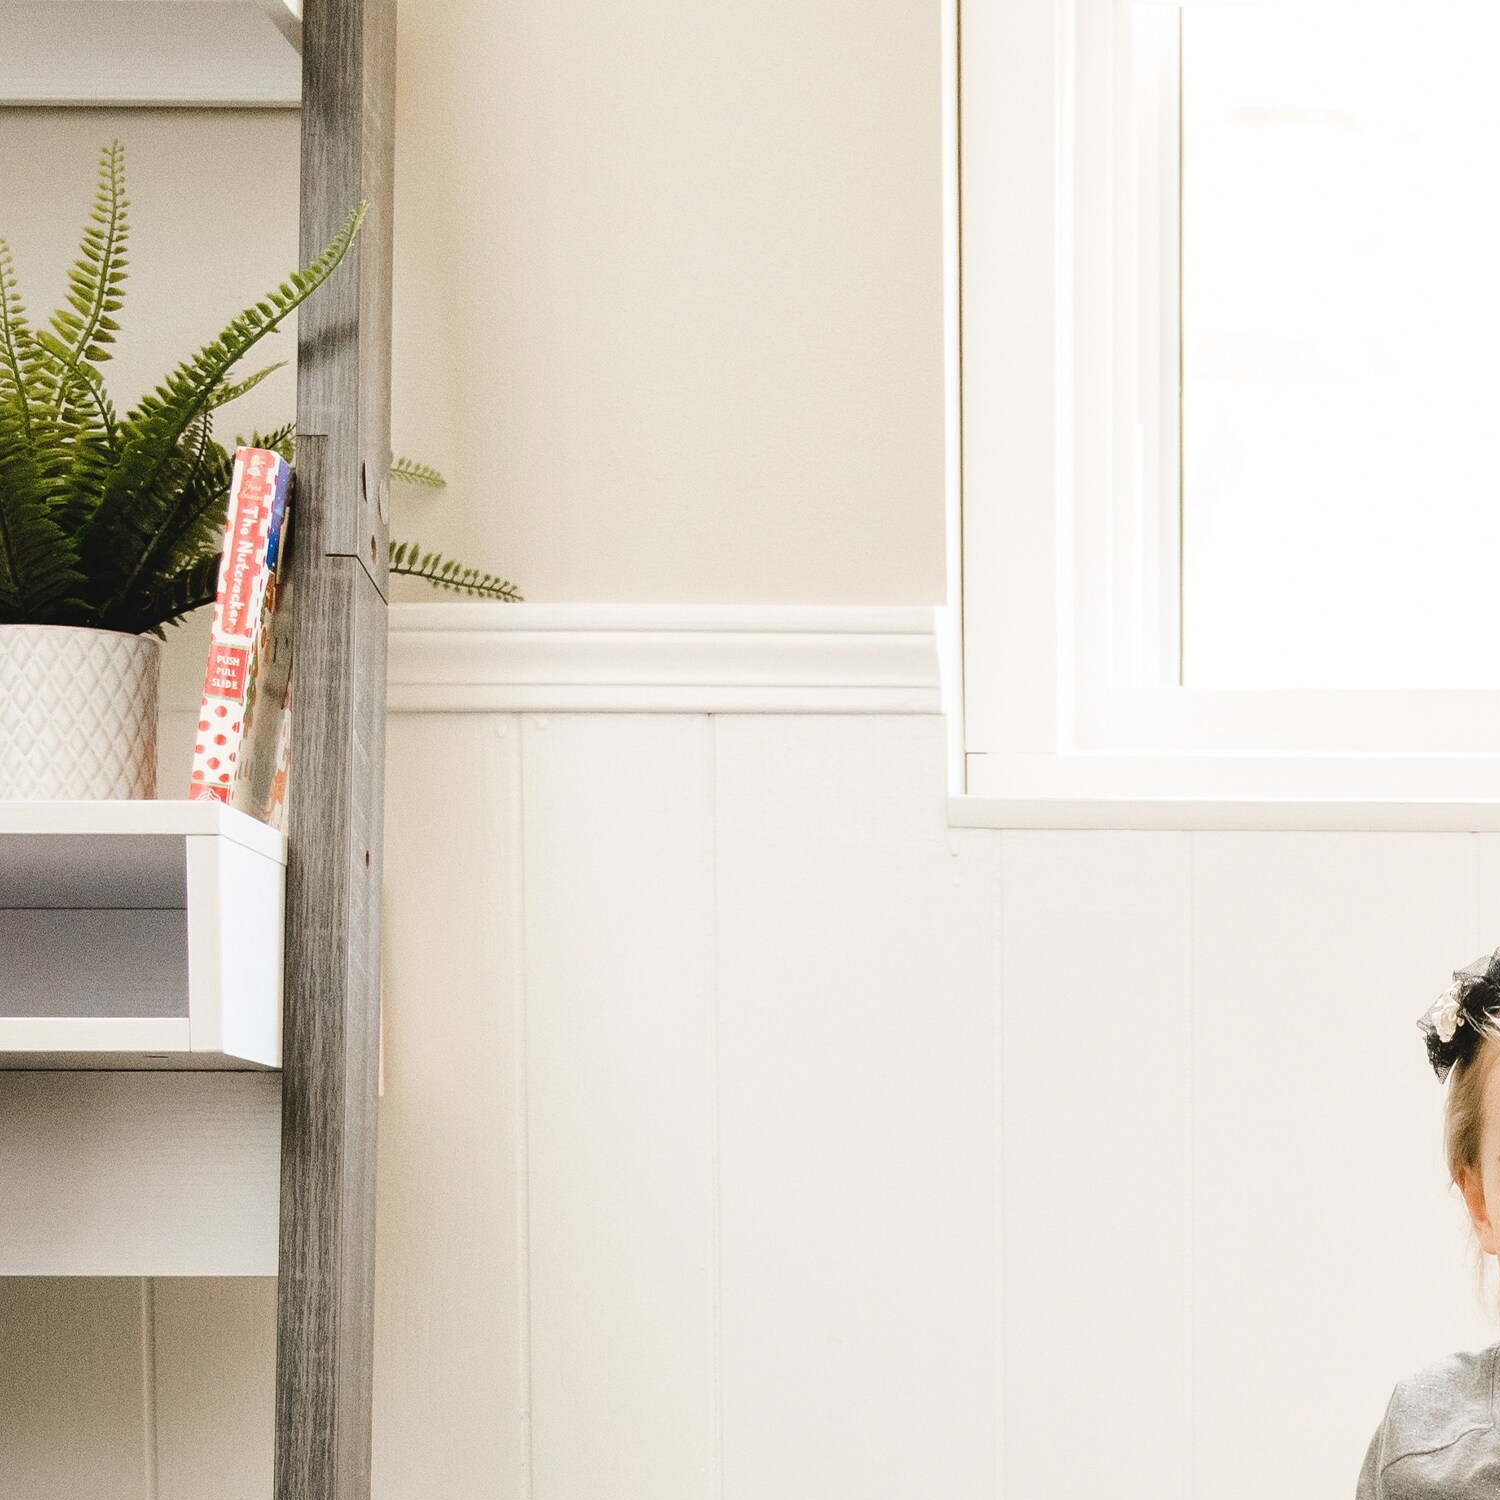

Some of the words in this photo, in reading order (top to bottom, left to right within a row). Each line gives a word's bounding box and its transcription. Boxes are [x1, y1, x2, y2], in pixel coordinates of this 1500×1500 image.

[240, 505, 259, 536] The
[228, 540, 254, 627] Nutcracker
[216, 655, 240, 667] PUSH
[216, 667, 236, 678] PULL
[211, 677, 238, 690] SLIDE
